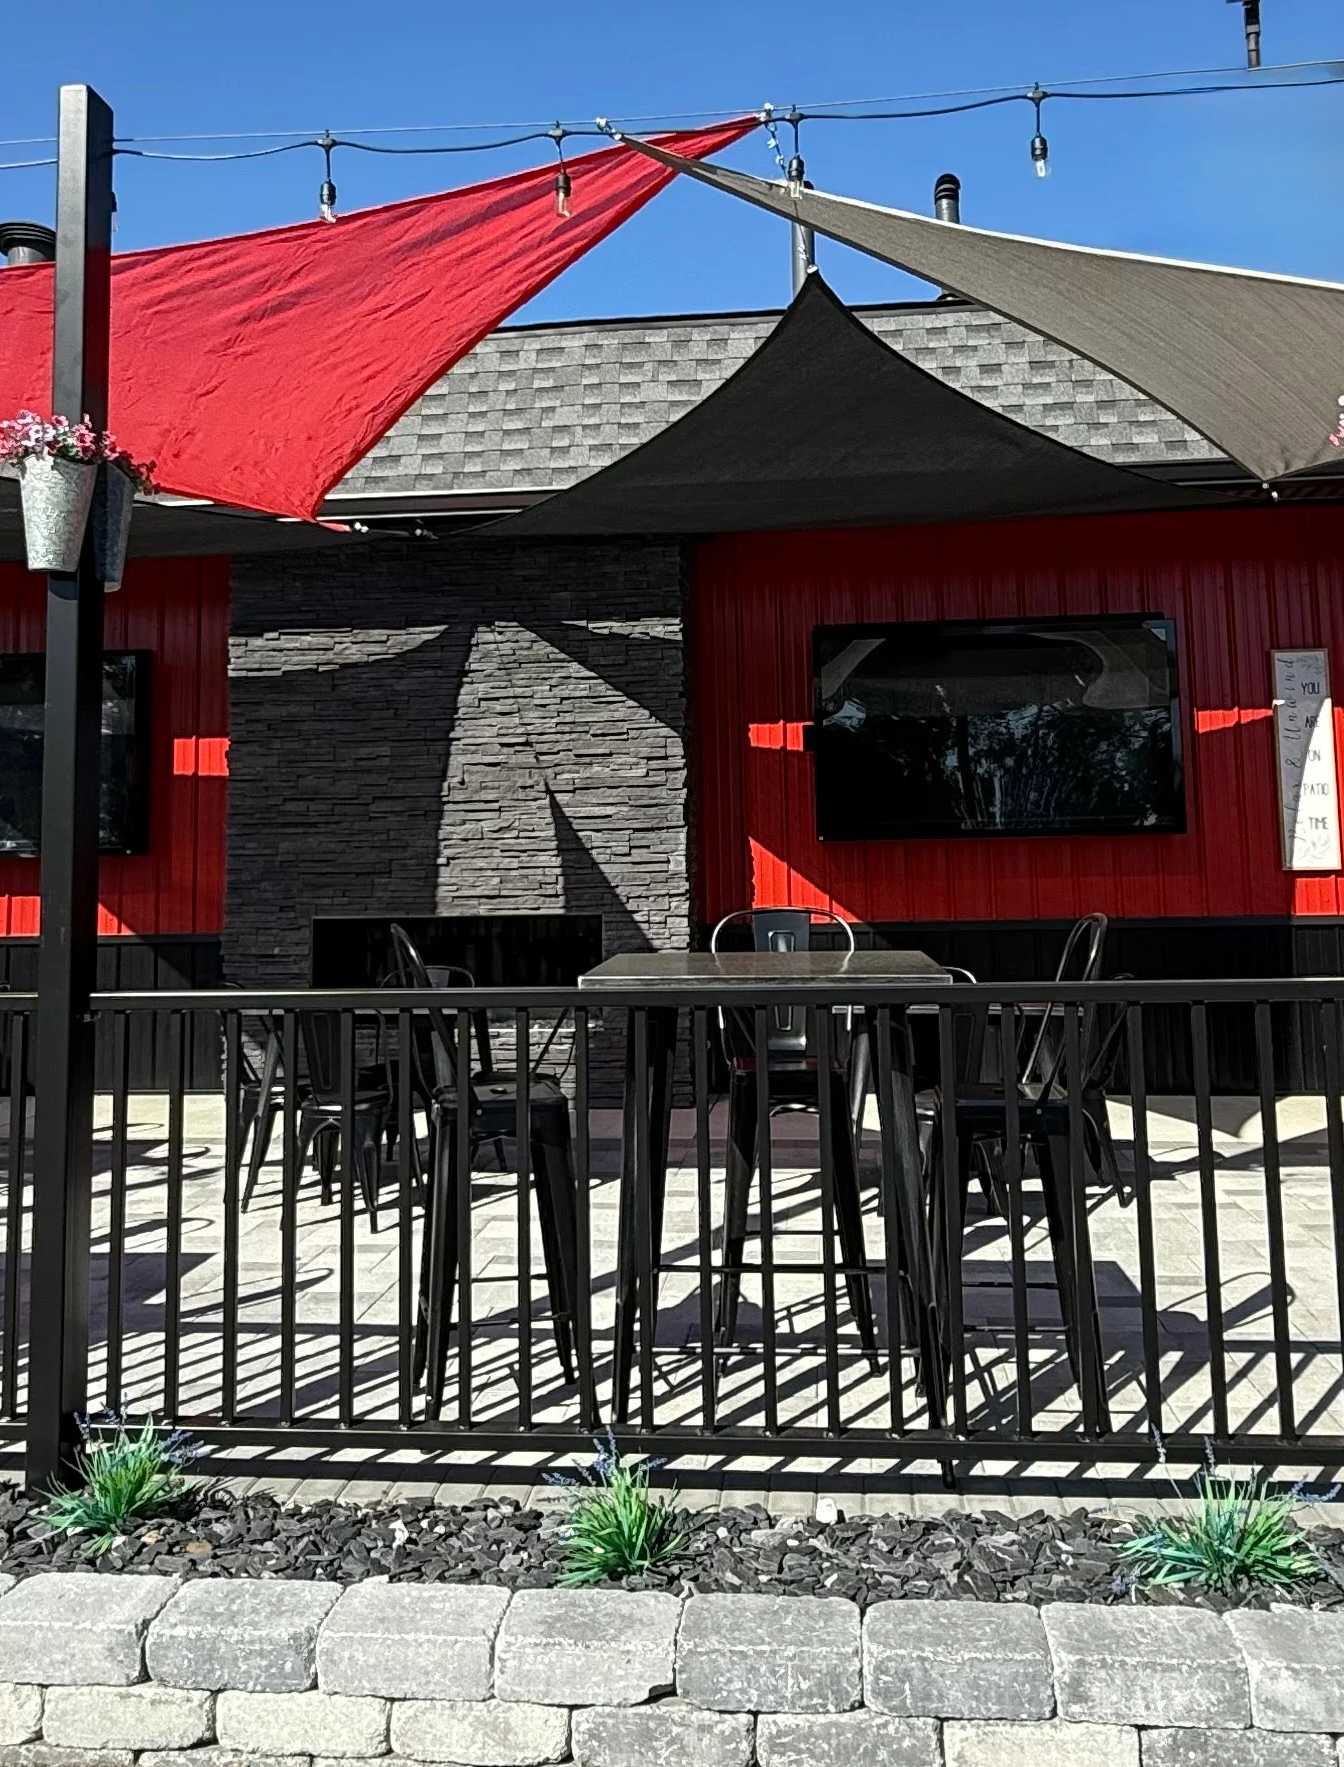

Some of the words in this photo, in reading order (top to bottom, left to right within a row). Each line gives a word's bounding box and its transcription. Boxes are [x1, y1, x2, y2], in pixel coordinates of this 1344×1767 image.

[1301, 682, 1320, 695] YOU
[1305, 715, 1321, 728] ARE
[1308, 749, 1321, 761] ON
[1303, 783, 1329, 795] PATIO
[1309, 816, 1329, 830] TIME
